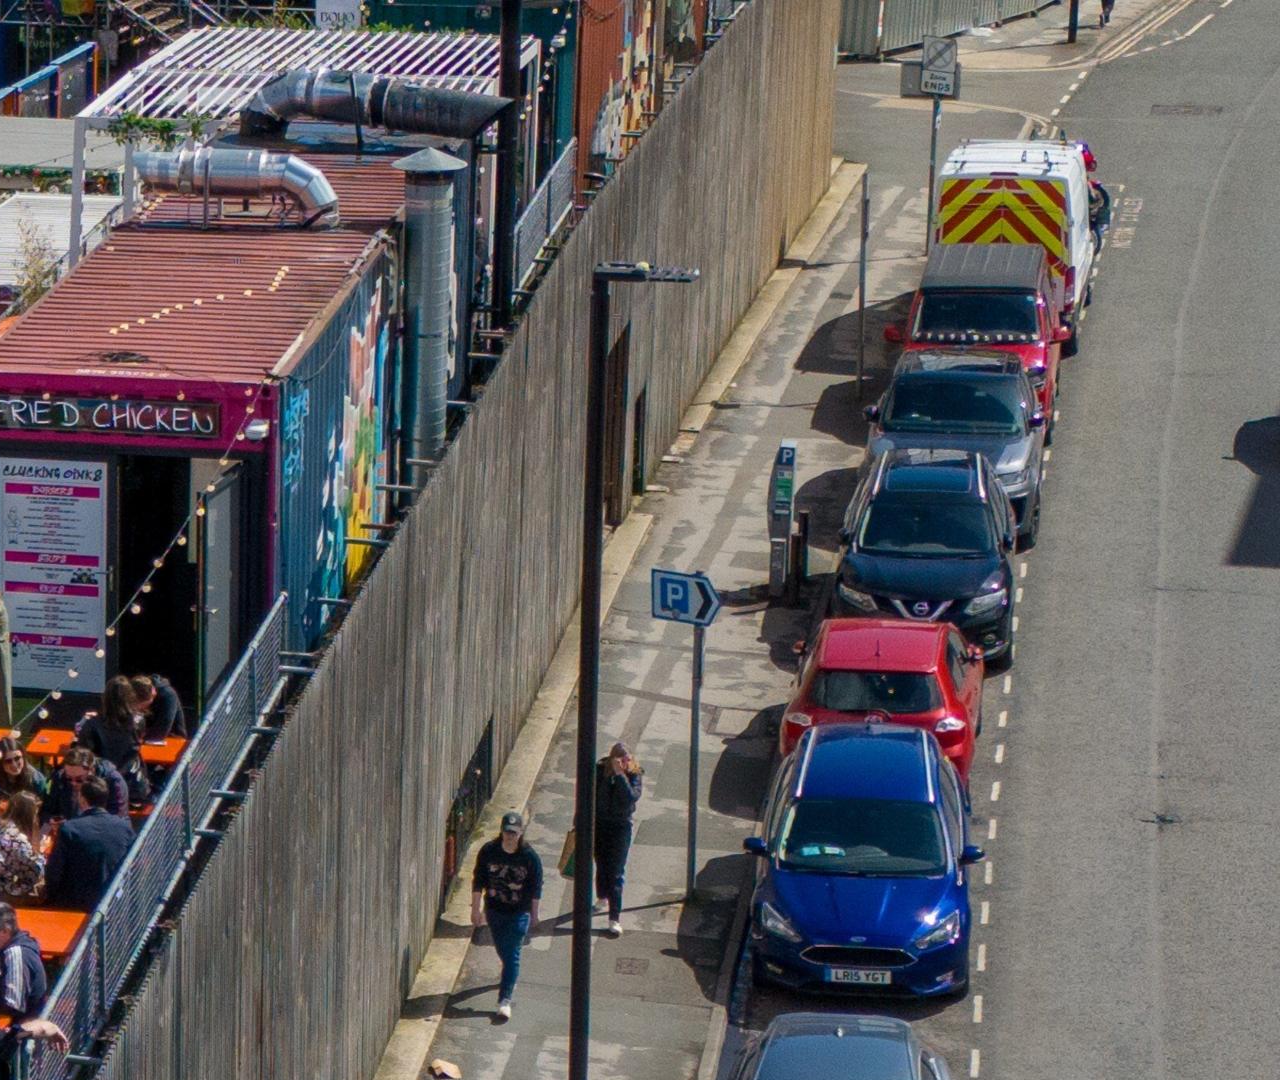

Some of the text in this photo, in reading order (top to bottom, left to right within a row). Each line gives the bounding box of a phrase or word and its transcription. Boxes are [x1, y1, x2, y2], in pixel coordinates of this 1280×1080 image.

[92, 402, 214, 434] CHICKEN
[782, 449, 793, 463] P
[2, 464, 103, 482] CLUCKING OINKS
[666, 582, 684, 608] P
[834, 970, 861, 982] LR15
